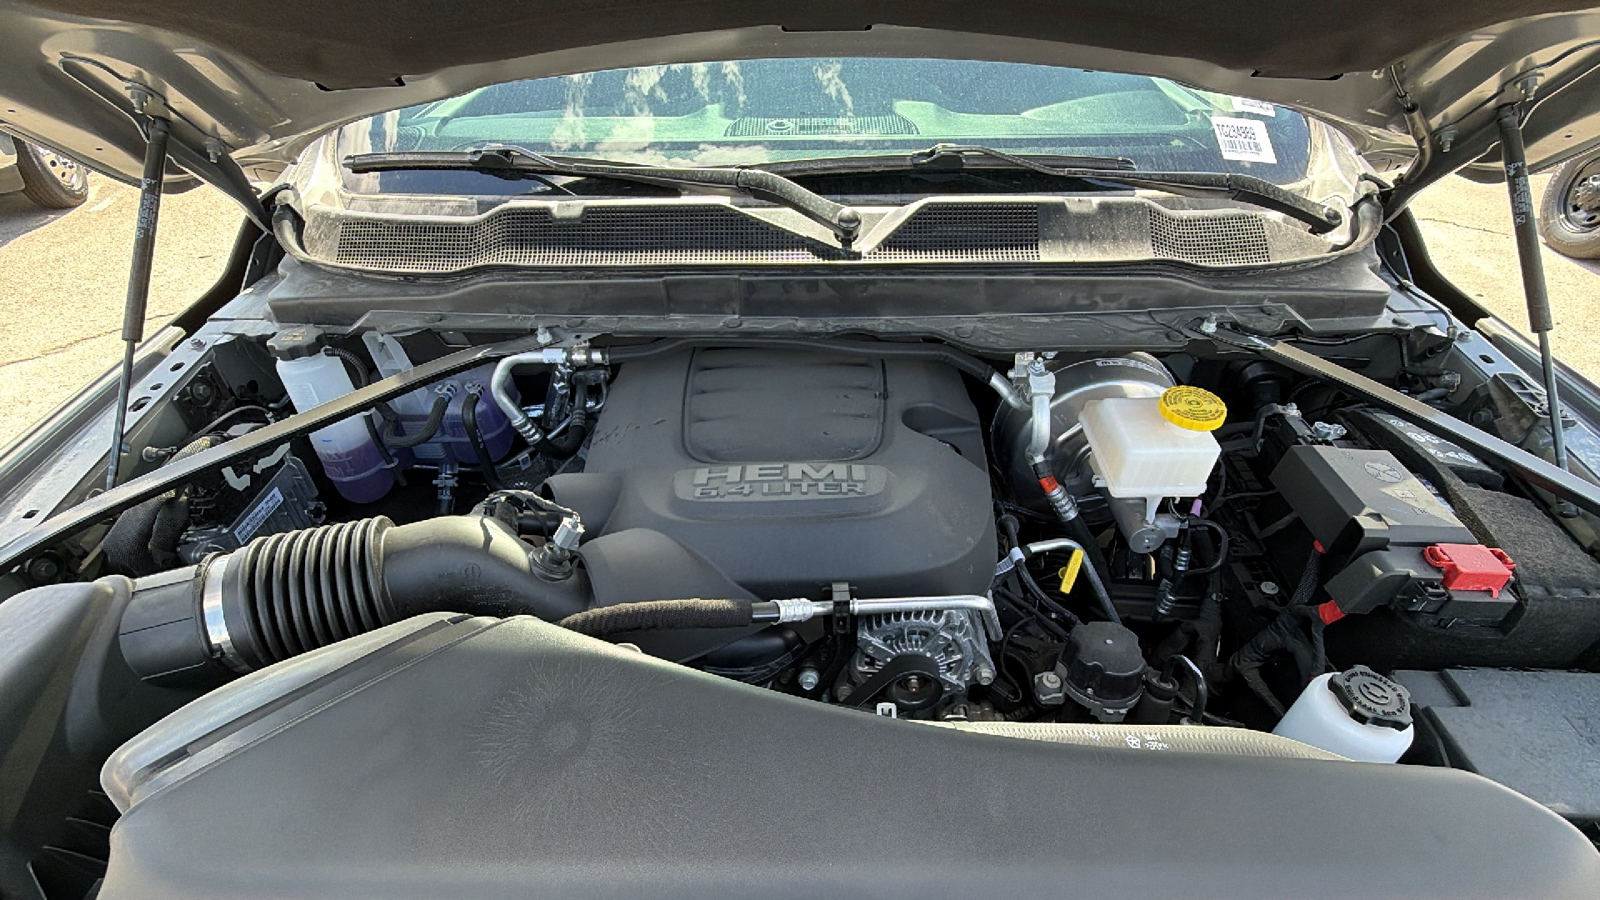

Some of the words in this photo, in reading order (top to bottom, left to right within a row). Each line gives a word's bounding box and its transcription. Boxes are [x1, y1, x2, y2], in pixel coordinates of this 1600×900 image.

[693, 463, 867, 486] HEMI
[694, 483, 754, 499] 6.4
[762, 481, 867, 496] LITER
